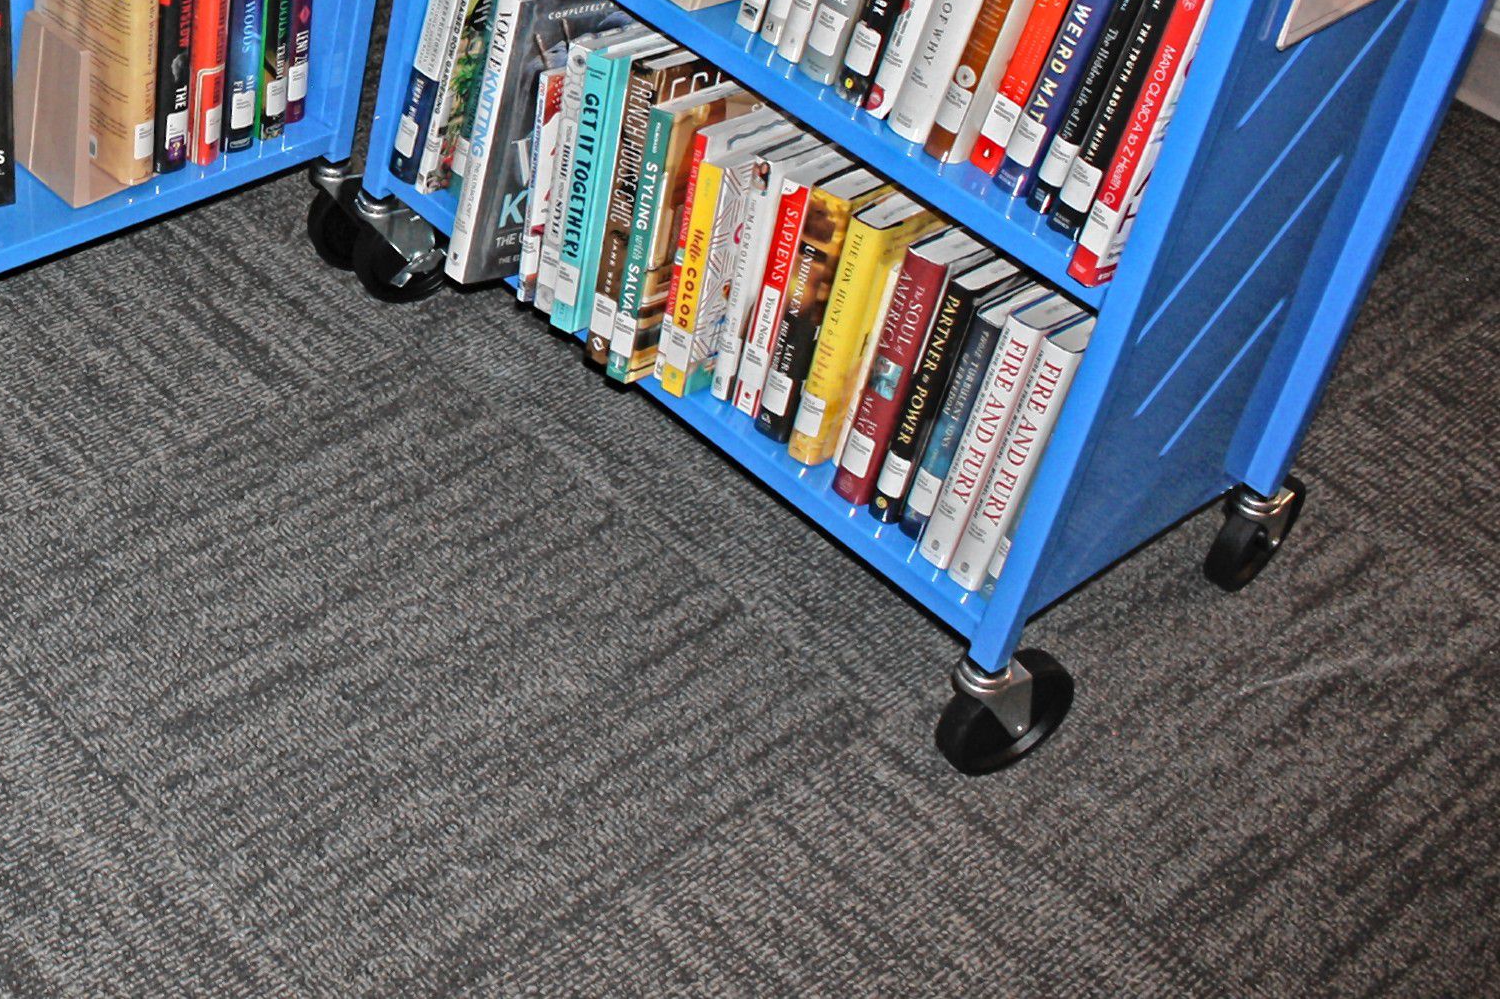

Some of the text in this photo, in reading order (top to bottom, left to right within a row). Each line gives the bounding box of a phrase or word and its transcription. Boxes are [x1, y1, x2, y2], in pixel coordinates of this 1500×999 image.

[548, 2, 607, 21] COMPLETELY
[923, 27, 946, 66] WHY
[939, 1, 954, 26] OF
[1050, 4, 1093, 73] WEIRD
[175, 85, 188, 109] THE
[471, 11, 513, 158] VOGUE KNITTING
[563, 93, 600, 259] GET IT TOGETHER!
[771, 209, 798, 284] SAPIENS
[676, 265, 698, 330] COLOR
[879, 272, 913, 350] AMERICA
[922, 294, 961, 372] PARTNER
[897, 385, 929, 445] POWER
[954, 334, 1029, 508] FIRE AND FURY
[981, 357, 1064, 527] FIRE AND FURY
